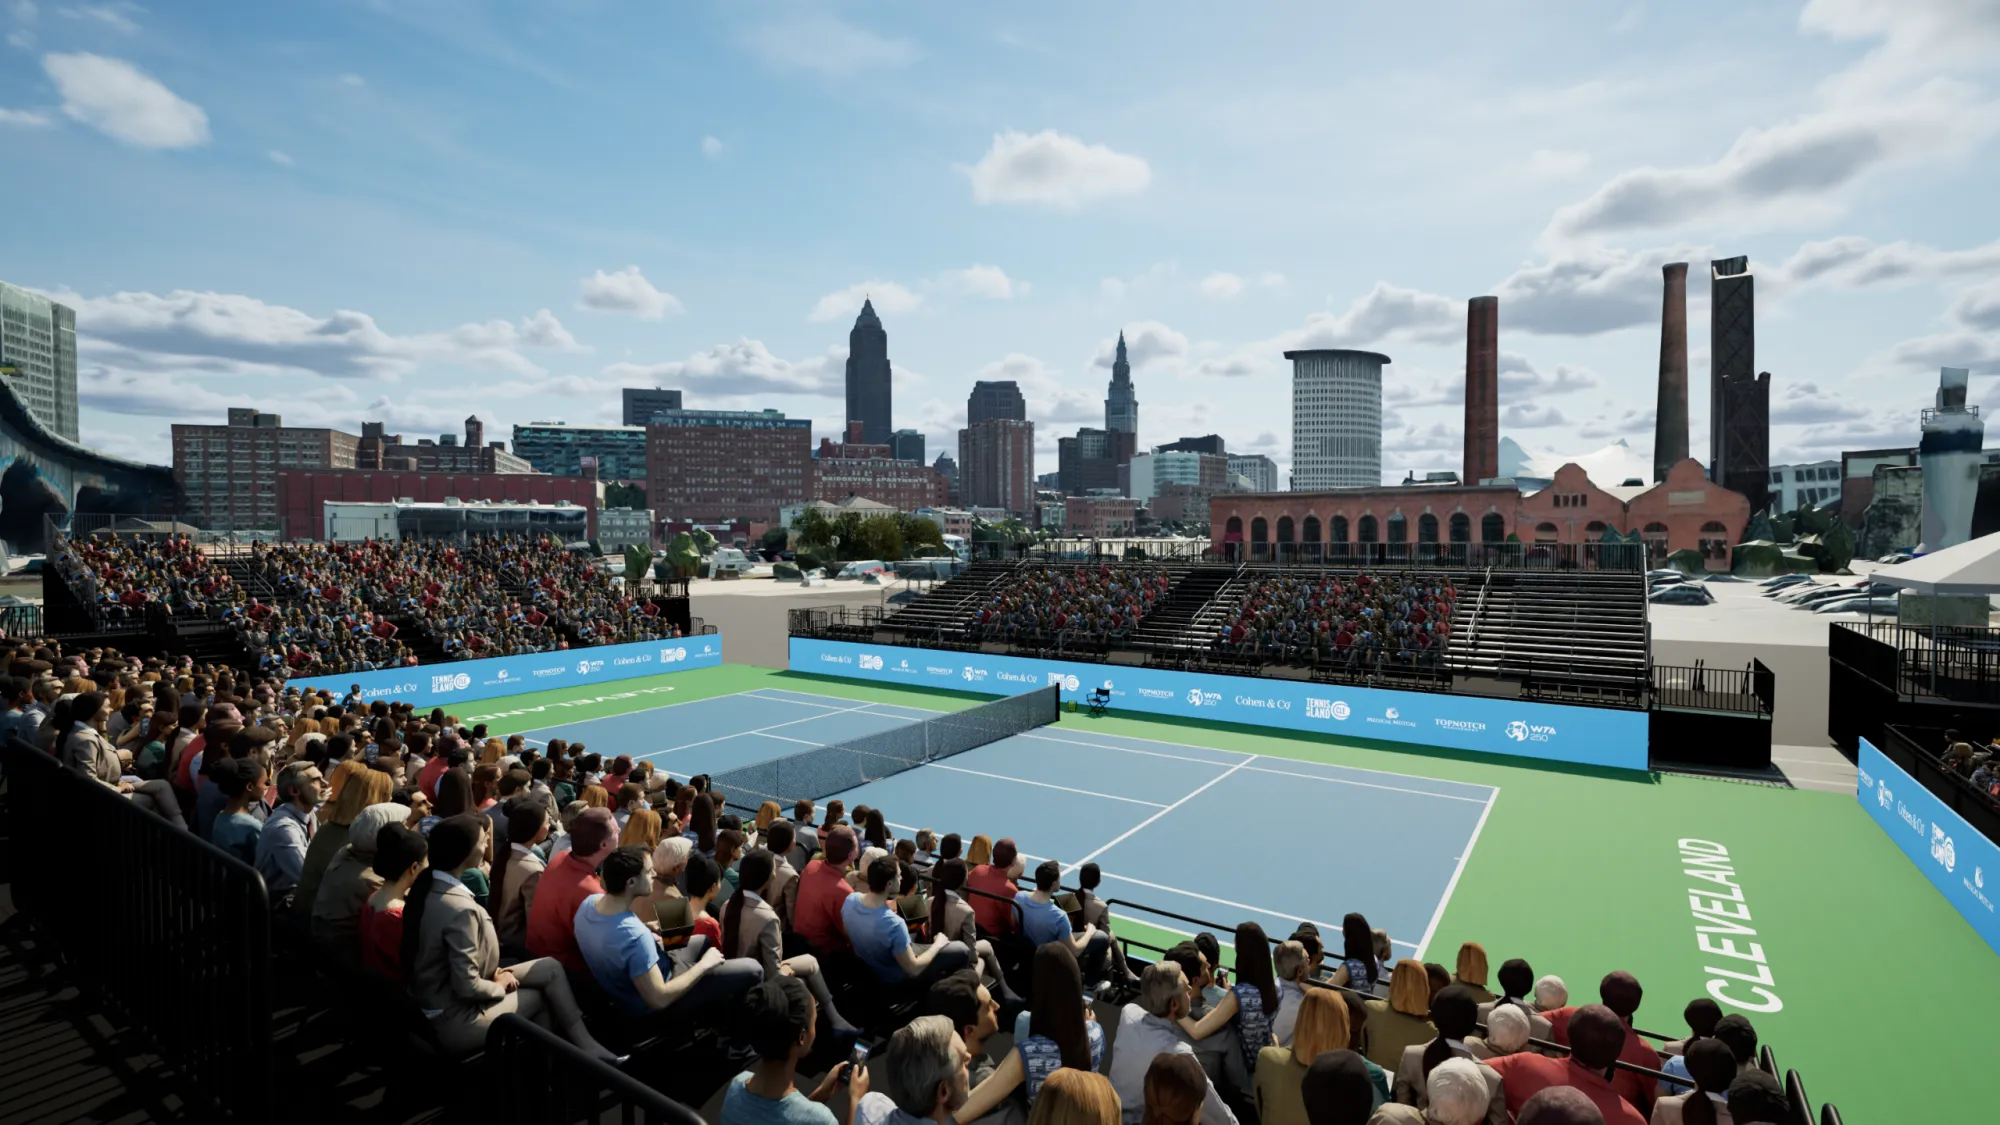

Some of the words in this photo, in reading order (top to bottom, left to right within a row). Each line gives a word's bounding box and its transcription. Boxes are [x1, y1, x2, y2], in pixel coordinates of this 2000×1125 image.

[716, 419, 786, 427] BINGHAM
[432, 674, 453, 684] TENNIS
[997, 671, 1018, 681] Cohen
[1019, 673, 1026, 682] &
[360, 687, 392, 698] Cohen
[393, 685, 402, 694] &
[1138, 688, 1174, 697] TOPNOTCH
[1204, 692, 1222, 700] WTA
[466, 686, 675, 722] CLEVELAND
[1235, 695, 1265, 707] Cohen
[1267, 699, 1276, 708] &
[1306, 697, 1330, 709] TENNIS
[1311, 707, 1330, 719] LAND
[1366, 717, 1391, 725] MEDICAL
[1435, 718, 1486, 730] TOPNOTCH
[1530, 725, 1556, 735] WTA
[1530, 733, 1548, 742] 250
[1678, 838, 1783, 1013] CLEVELAND
